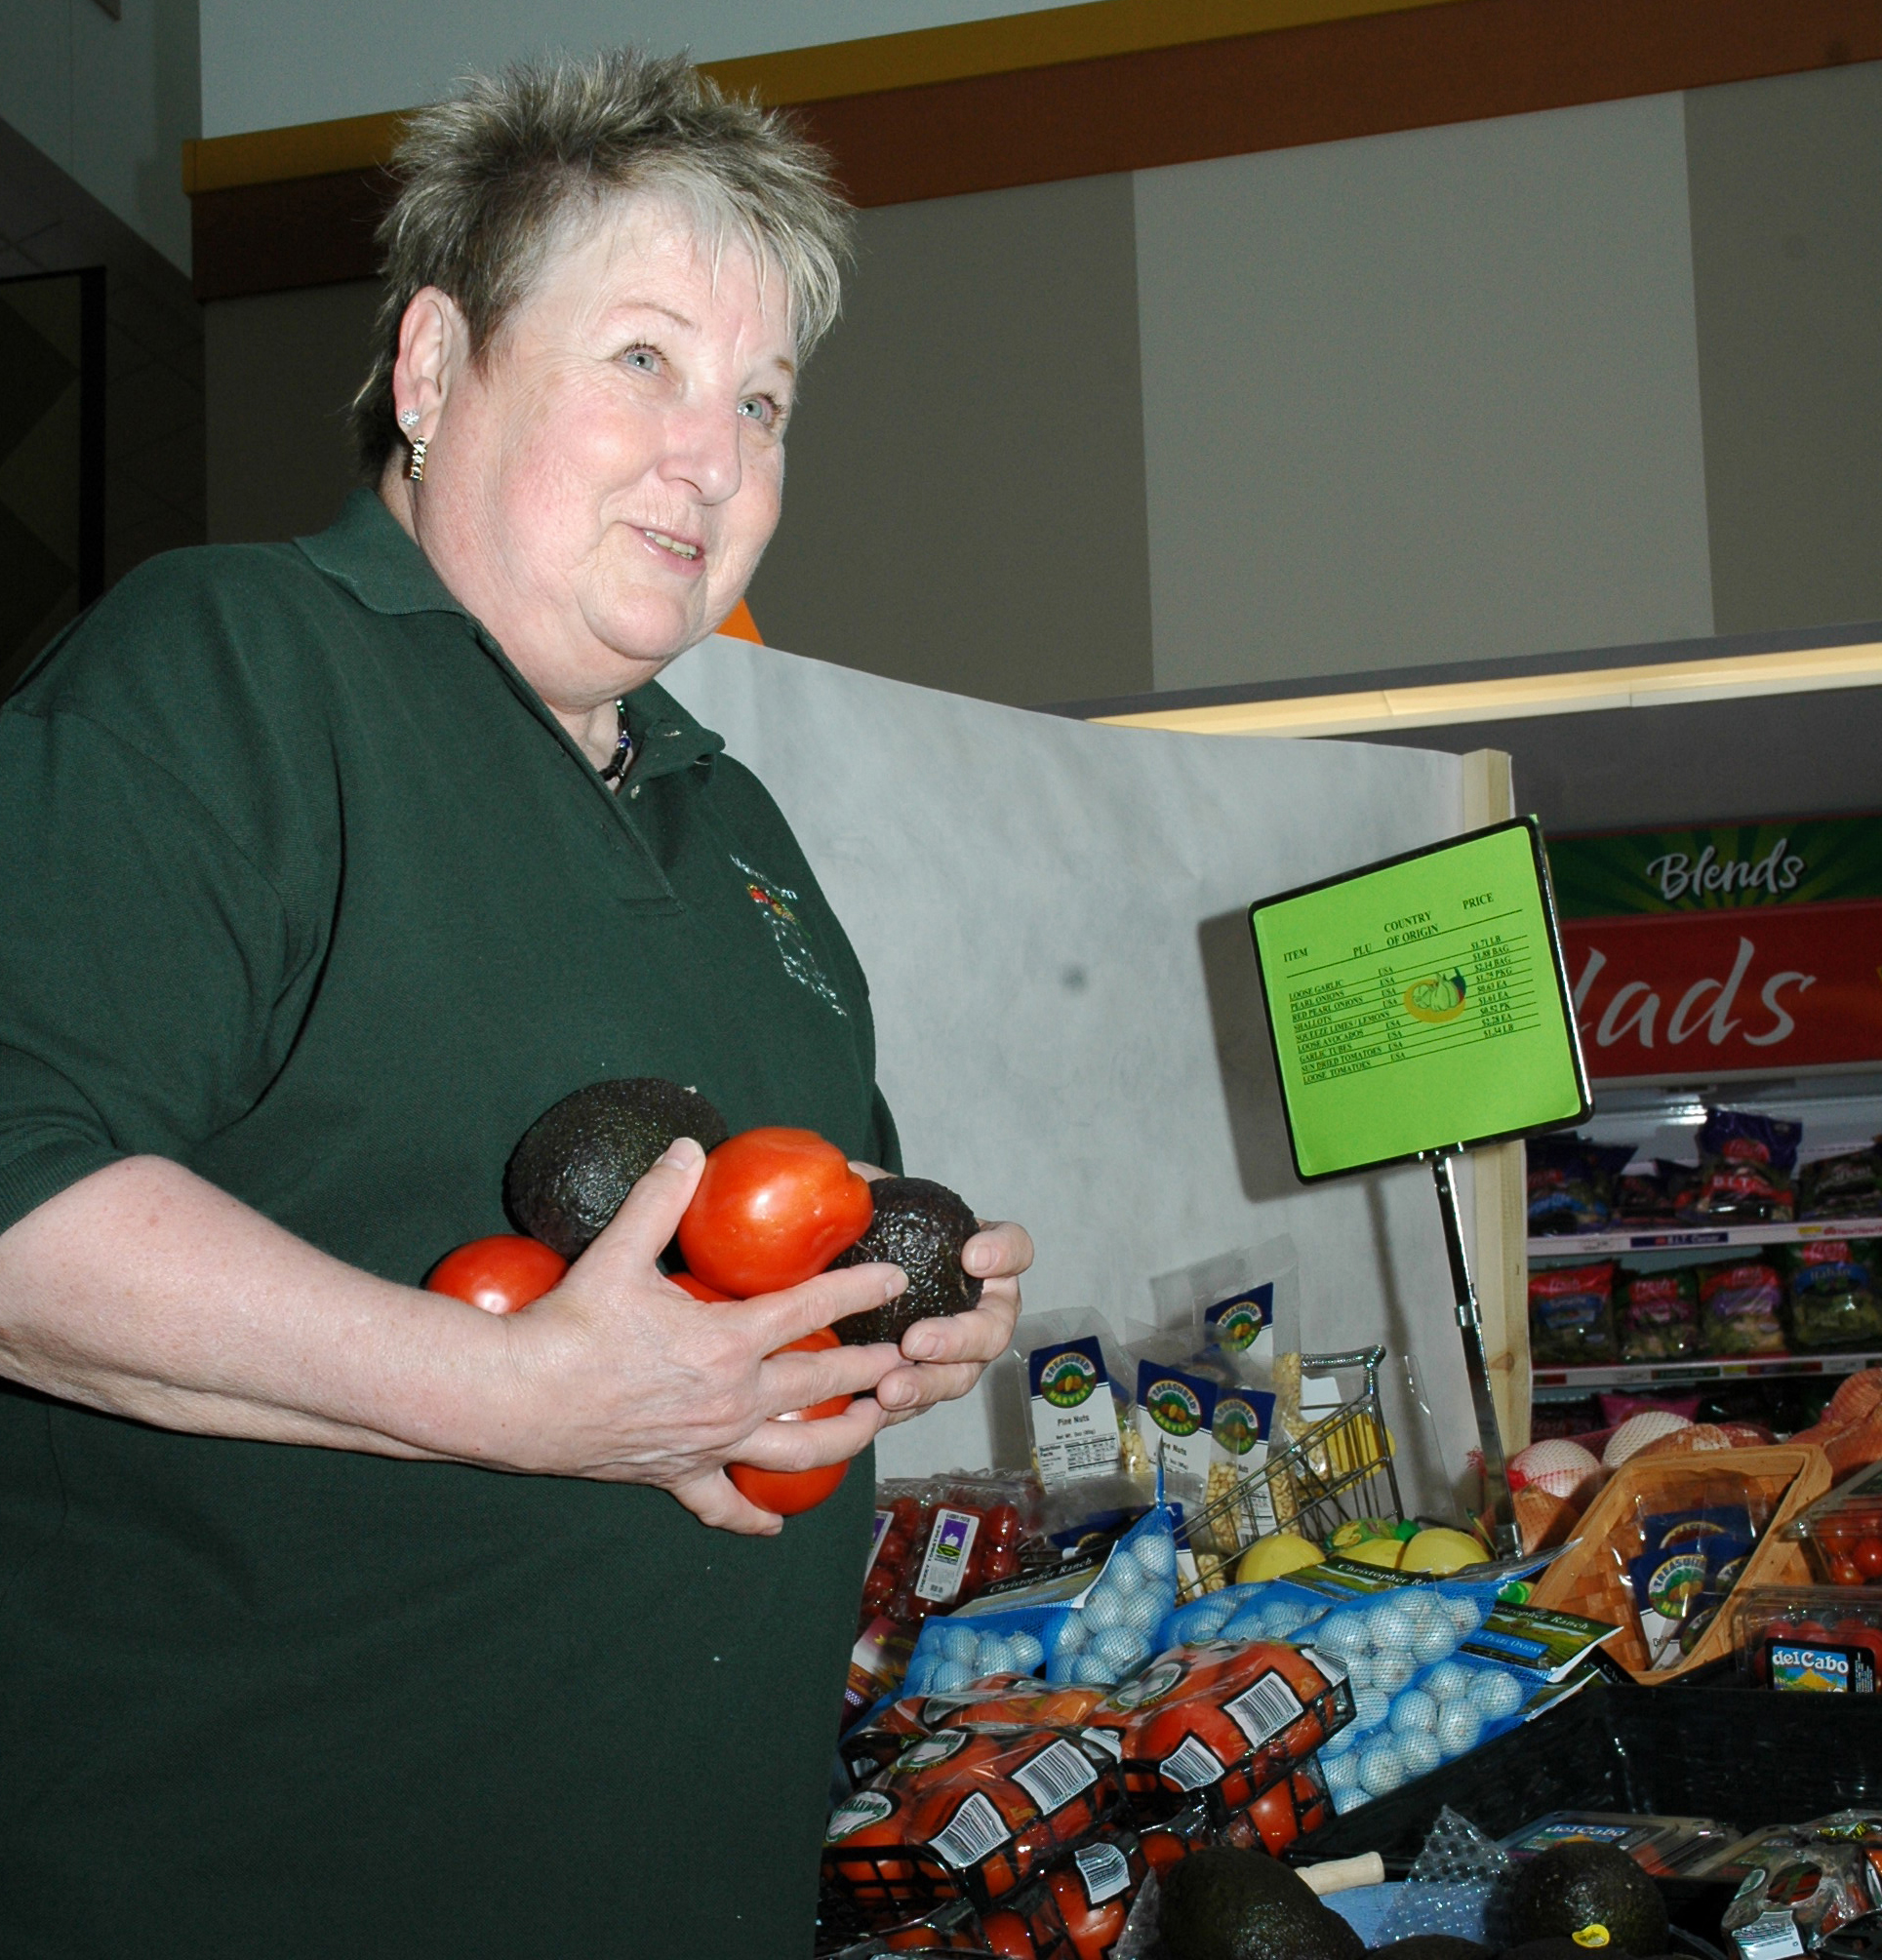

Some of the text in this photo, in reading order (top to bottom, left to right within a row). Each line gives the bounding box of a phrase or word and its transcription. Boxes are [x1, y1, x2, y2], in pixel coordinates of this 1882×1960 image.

[1646, 838, 1804, 900] Blends
[1462, 893, 1494, 909] PRICE
[1383, 911, 1431, 933] COUNTRY
[1386, 924, 1438, 946] OF ORIGIN
[1283, 947, 1308, 962] ITEM
[1352, 943, 1372, 957] PLU
[1289, 987, 1313, 1001] LOOSE
[1314, 979, 1342, 994] GARLIC
[1378, 965, 1392, 976] USA
[1291, 998, 1313, 1012] PEARL
[1315, 989, 1343, 1005] ONIONS
[1380, 976, 1393, 987] USA
[1492, 943, 1508, 956] BAG
[1293, 1011, 1306, 1021] RED
[1308, 1004, 1332, 1018] PEARL
[1334, 995, 1362, 1011] ONIONS
[1381, 986, 1395, 998] USA
[1494, 955, 1510, 967] BAG
[1574, 937, 1817, 1049] lads
[1294, 1015, 1331, 1032] SHALLOTS
[1382, 997, 1396, 1009] USA
[1296, 1026, 1329, 1043] SQUEEZE
[1331, 1020, 1352, 1033] LIMES
[1358, 1011, 1389, 1026] LEMONS
[1298, 1039, 1322, 1053] LOOSE
[1323, 1028, 1363, 1046] AVOCADOS
[1385, 1019, 1399, 1029] USA
[1300, 1049, 1327, 1063] GARLIC
[1329, 1043, 1351, 1056] TUBES
[1386, 1029, 1401, 1040] USA
[1301, 1063, 1315, 1073] SUN
[1341, 1046, 1381, 1063] TOMATOES
[1387, 1040, 1402, 1051] USA
[1303, 1071, 1326, 1084] LOOSE
[1330, 1060, 1370, 1077] TOMATOES
[1390, 1051, 1404, 1061] USA
[1045, 1353, 1091, 1379] TREASURED
[1049, 1382, 1090, 1405] HARVEST
[989, 1557, 1092, 1593] Christopher Ranch
[1338, 1563, 1408, 1583] Christopher
[1550, 1615, 1588, 1629] Ranch
